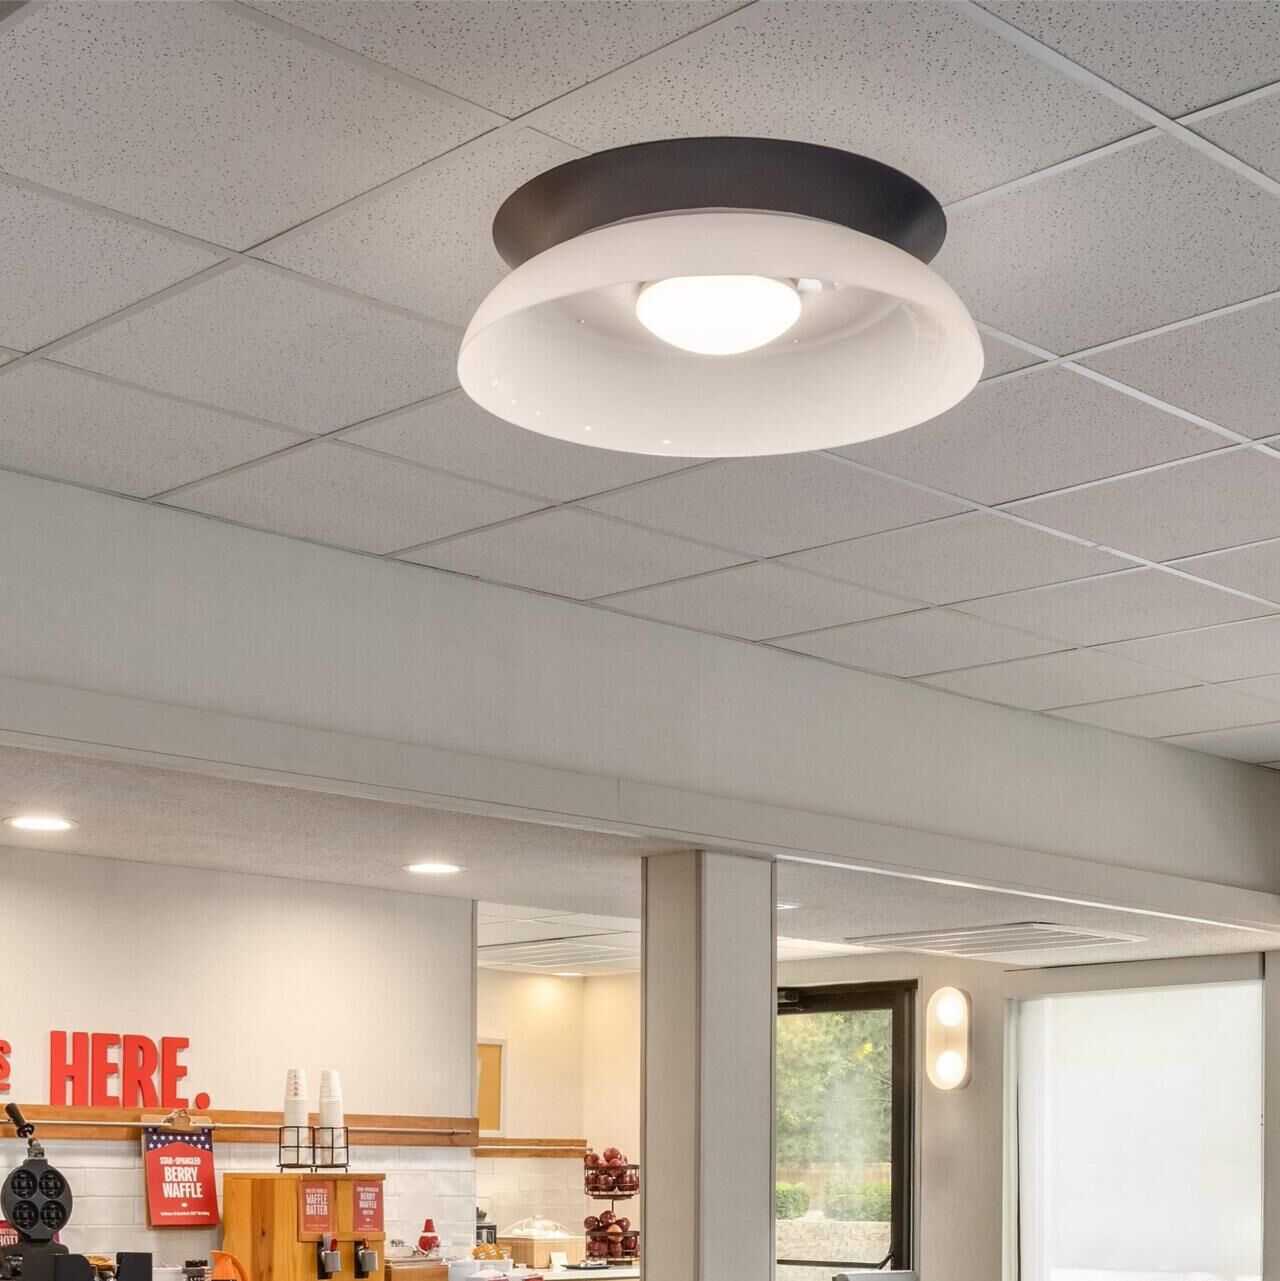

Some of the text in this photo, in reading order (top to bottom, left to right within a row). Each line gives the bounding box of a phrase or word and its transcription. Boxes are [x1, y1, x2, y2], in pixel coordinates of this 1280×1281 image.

[49, 1030, 211, 1111] HERE.
[163, 1166, 199, 1182] BERRY
[162, 1182, 204, 1199] WAFFLE
[306, 1193, 328, 1205] WAFFLE
[306, 1204, 328, 1216] BATTER
